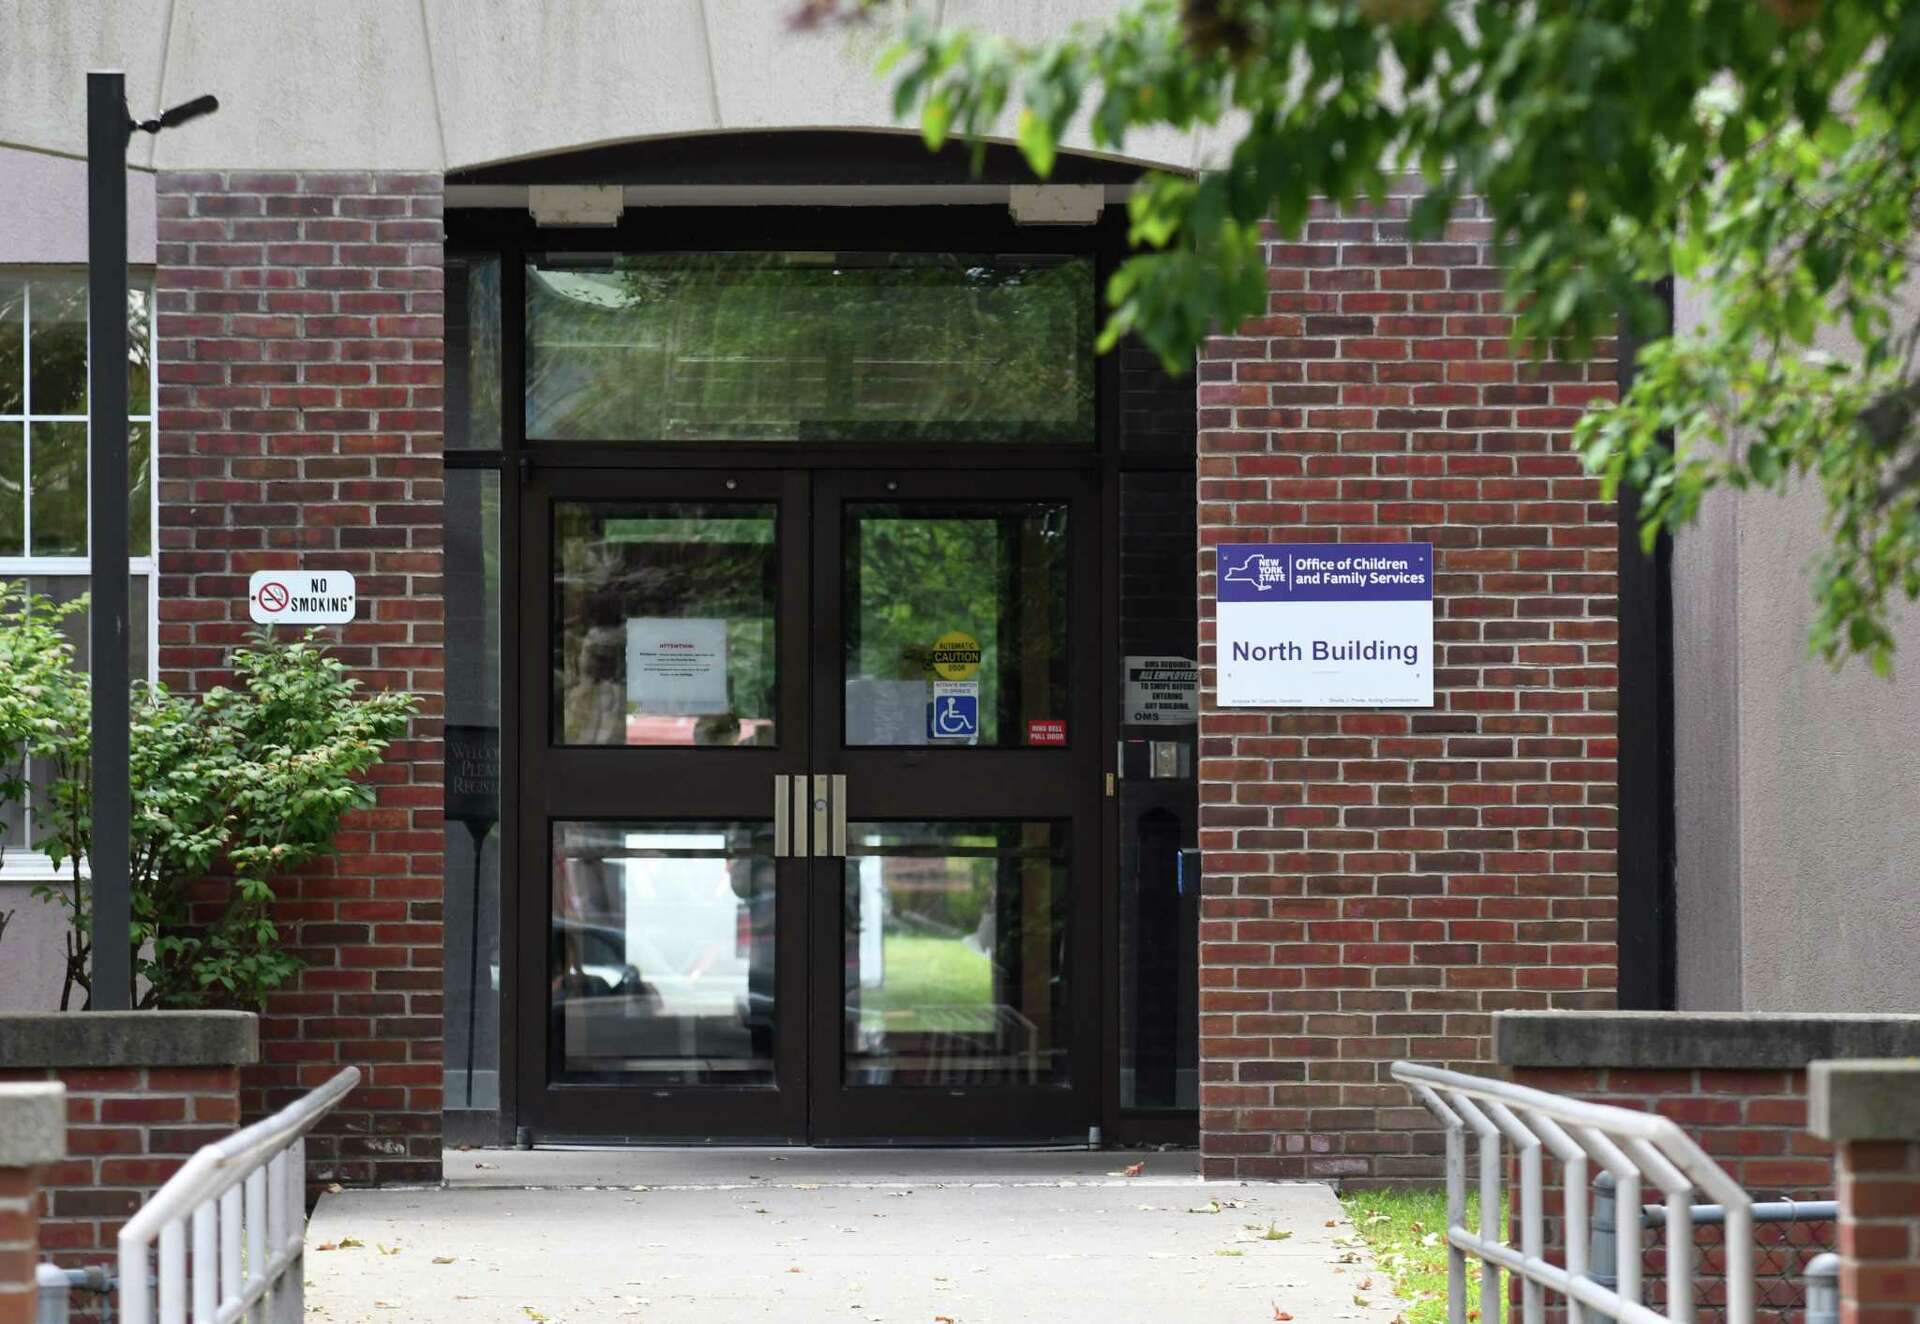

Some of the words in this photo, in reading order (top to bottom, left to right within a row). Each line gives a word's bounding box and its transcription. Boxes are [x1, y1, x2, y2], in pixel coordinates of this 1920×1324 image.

[1296, 558, 1334, 570] Office
[1337, 558, 1351, 570] of
[1354, 558, 1408, 570] Children
[1259, 566, 1283, 574] YORK
[1296, 572, 1320, 584] and
[1324, 572, 1365, 587] Family
[1370, 572, 1425, 584] Services
[311, 578, 327, 593] NO
[291, 597, 348, 612] SMOKING
[935, 652, 979, 662] CAUTION
[1232, 641, 1302, 661] North
[1312, 640, 1418, 665] Building
[1139, 670, 1153, 680] ALL
[1153, 670, 1197, 680] EMPLOYEES
[1152, 692, 1183, 700] ENTERING
[1134, 712, 1160, 721] OMS
